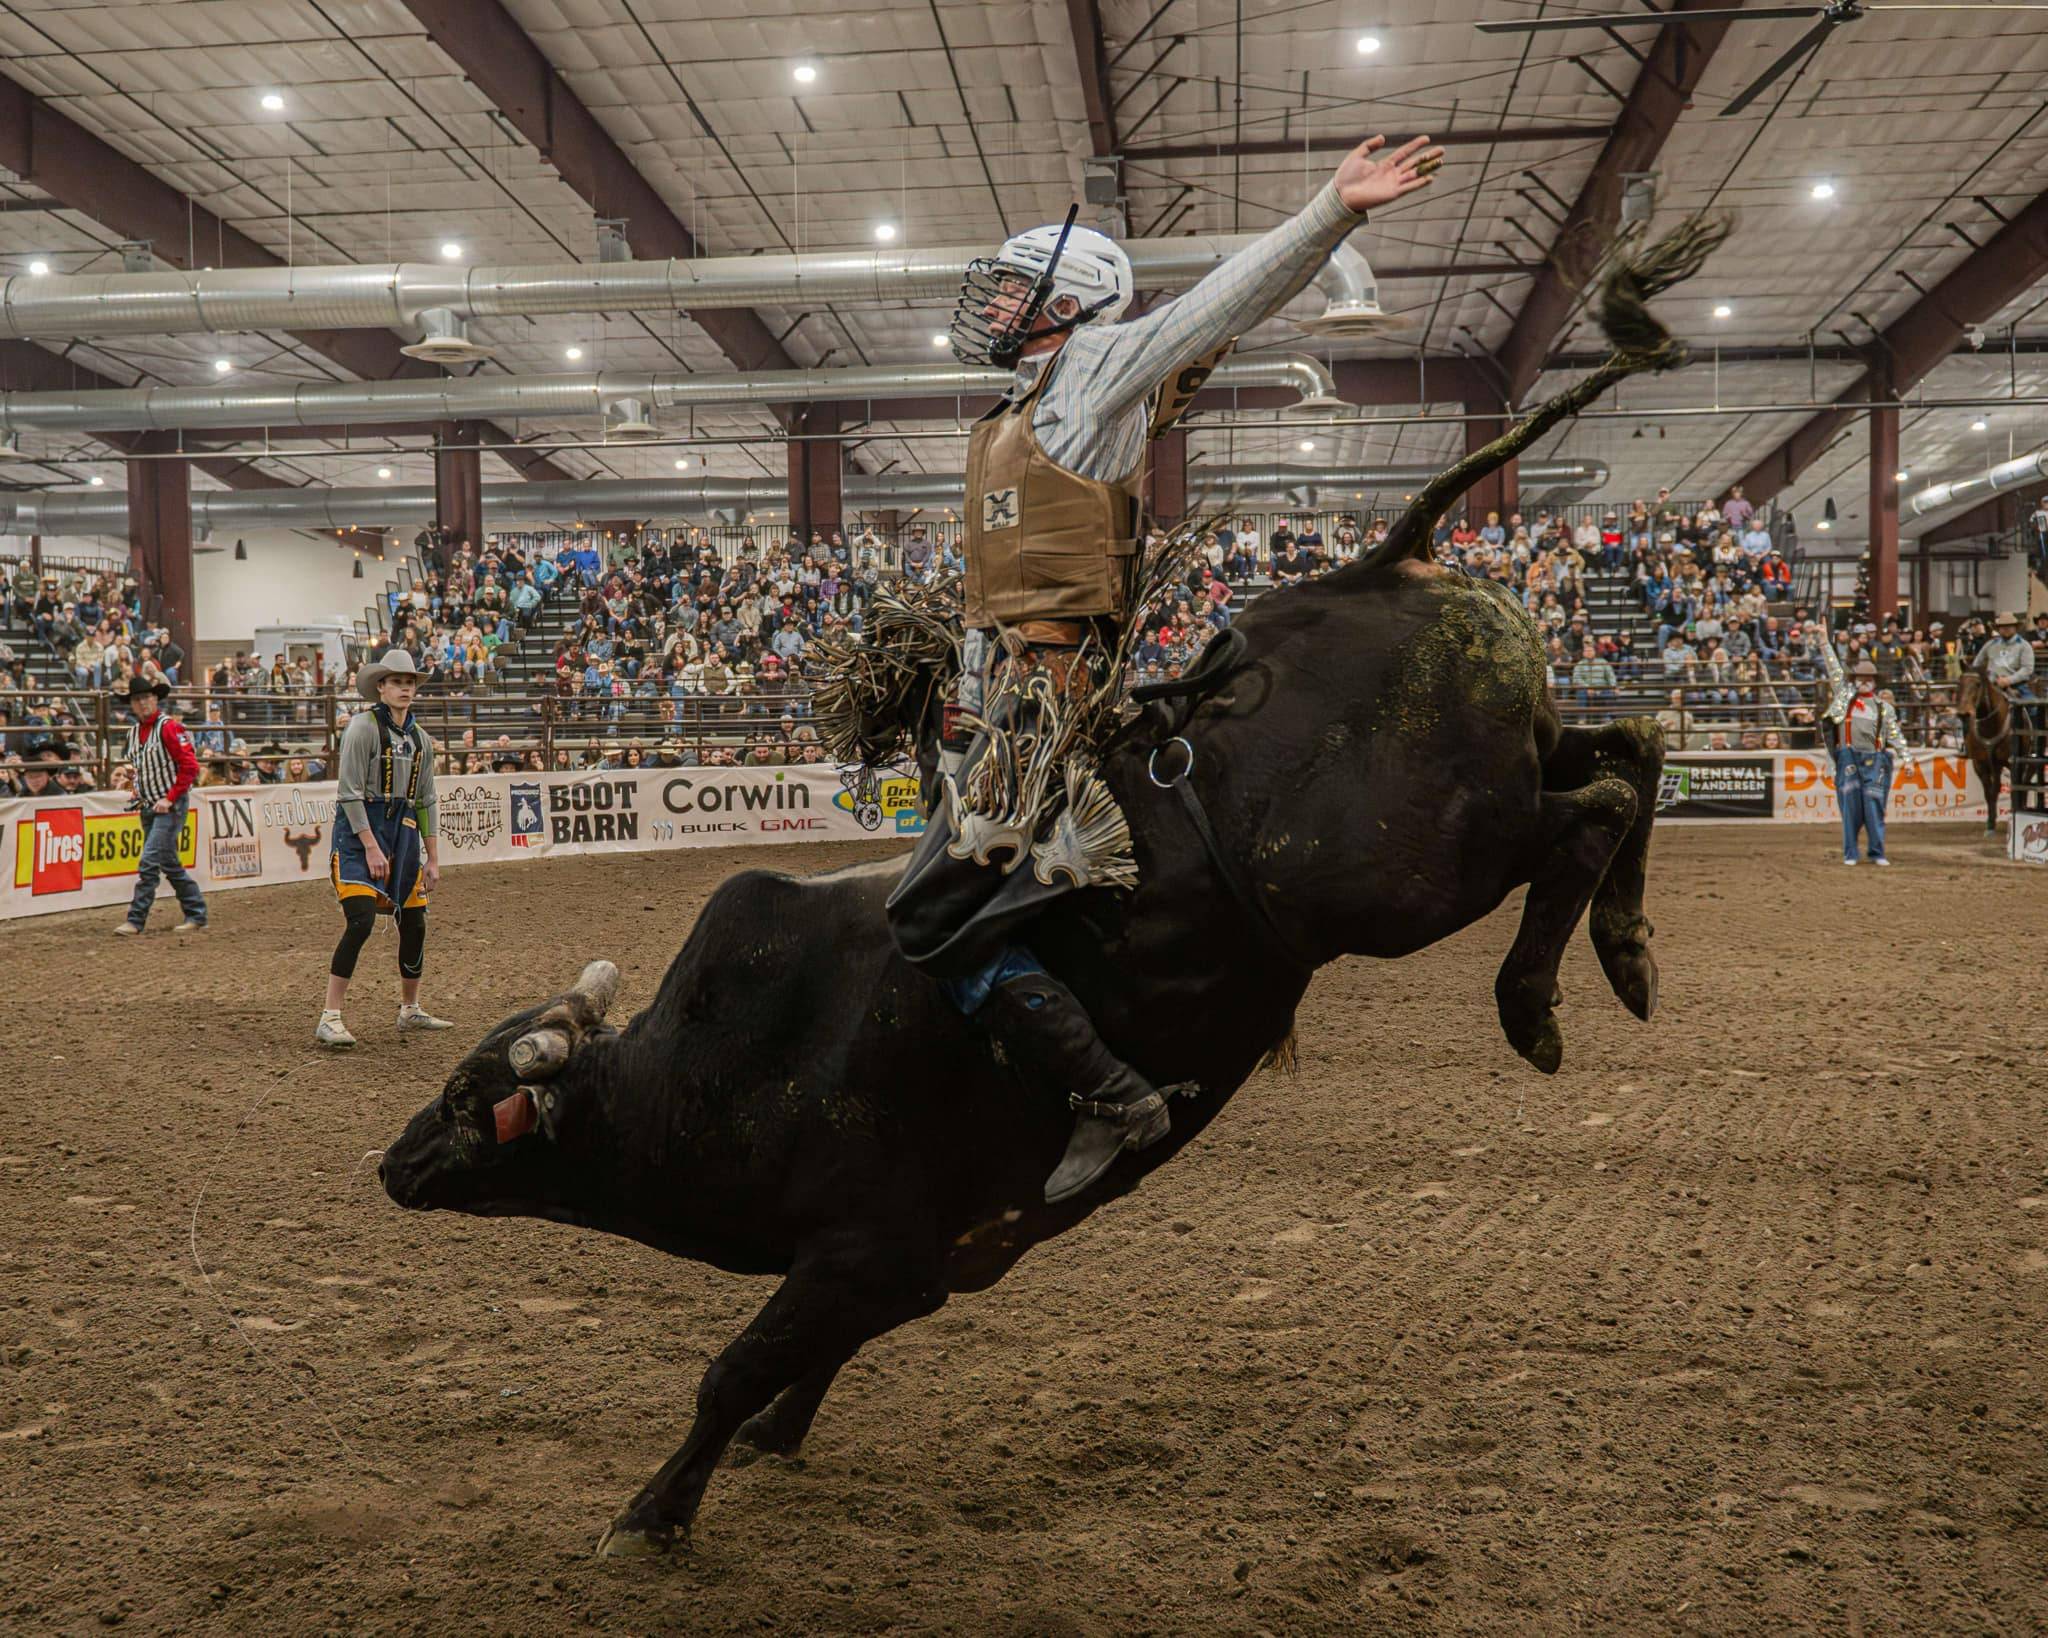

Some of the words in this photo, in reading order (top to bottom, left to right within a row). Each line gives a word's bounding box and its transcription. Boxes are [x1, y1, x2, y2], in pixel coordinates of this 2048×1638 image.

[1690, 767, 1766, 780] RENEWAL
[1701, 781, 1766, 791] ANDERSEN
[1784, 757, 1967, 790] DAN
[548, 781, 638, 812] BOOT
[663, 772, 810, 814] Corwin
[1785, 795, 1836, 809] AUT
[1894, 793, 1967, 808] ROUP
[440, 811, 473, 832] CUSTOM
[551, 812, 639, 844] BARN
[681, 822, 748, 834] BUICK
[761, 817, 828, 832] GMC
[36, 821, 83, 873] Tires
[88, 830, 116, 862] LES
